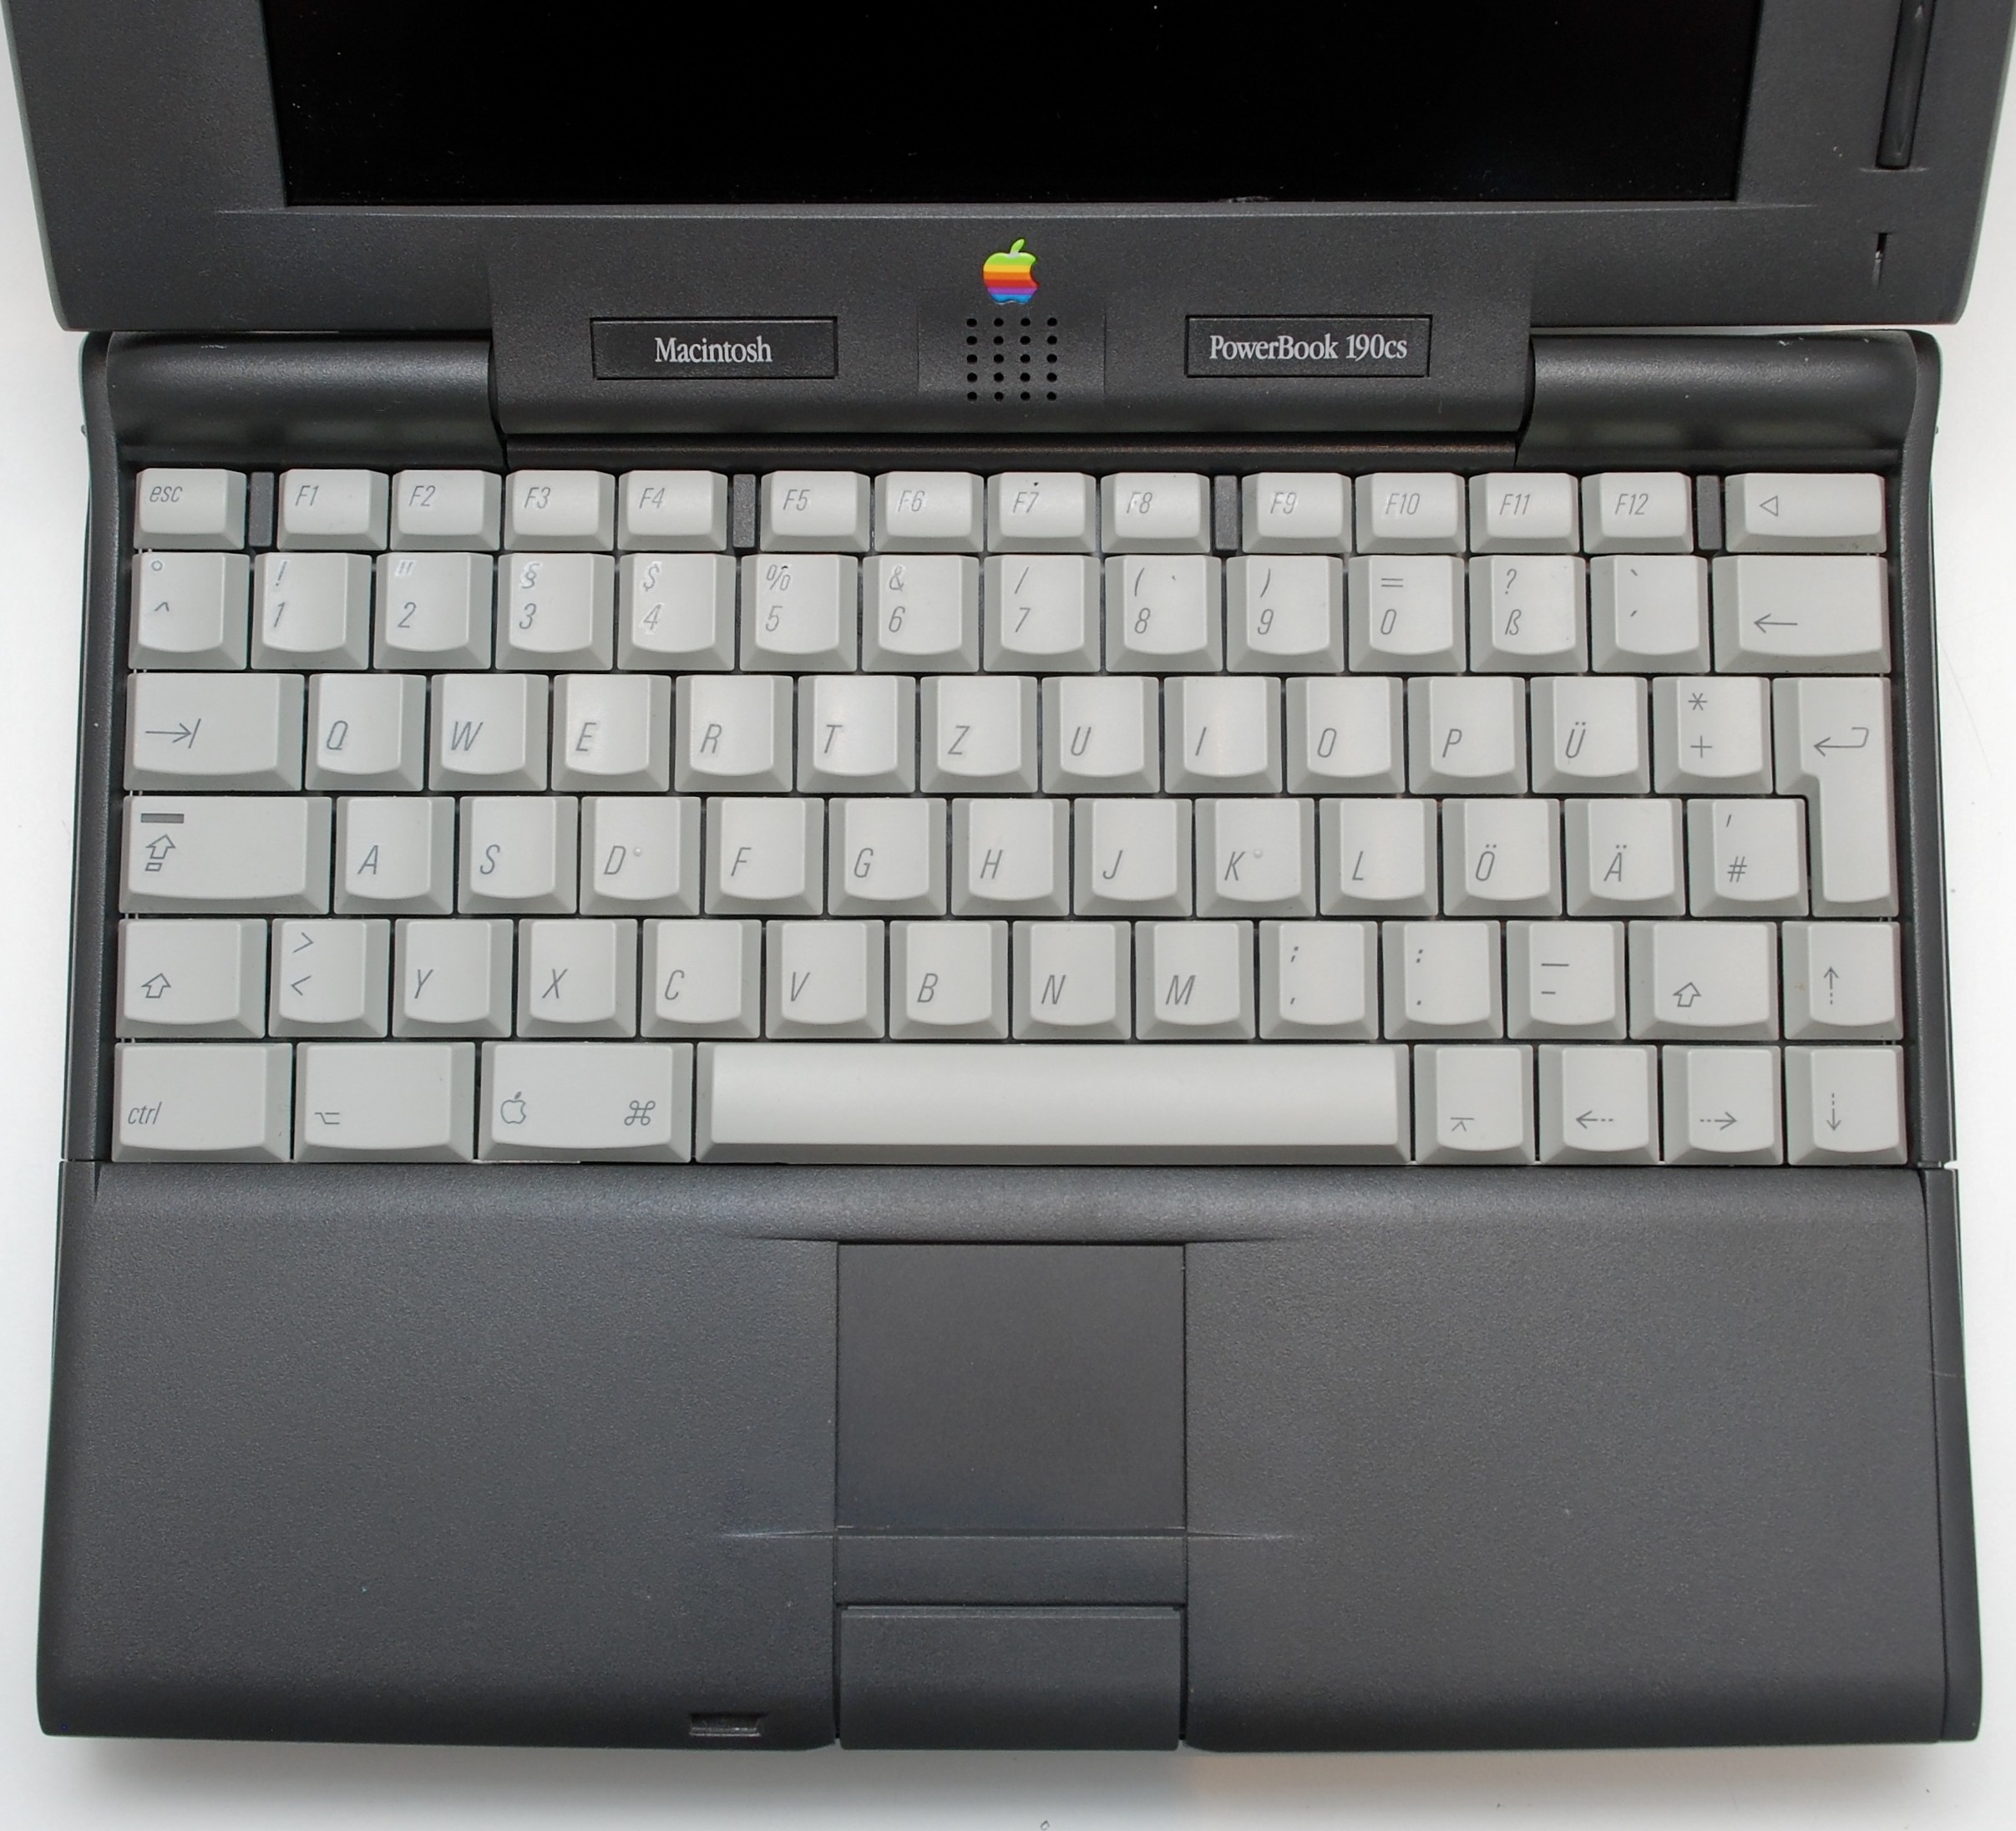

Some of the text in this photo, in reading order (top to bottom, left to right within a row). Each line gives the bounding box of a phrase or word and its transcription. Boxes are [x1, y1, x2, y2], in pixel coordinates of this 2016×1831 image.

[654, 335, 773, 363] Macintosh
[1209, 332, 1408, 362] PowerBook 190cs
[149, 485, 183, 503] esc
[295, 484, 320, 506] F1
[408, 484, 436, 507] F2
[524, 486, 551, 509] F3
[639, 487, 666, 510] F4
[783, 489, 811, 511] F5
[897, 489, 925, 513] F6
[1012, 491, 1040, 514] F7
[1126, 491, 1153, 515] F8
[1269, 491, 1297, 515] F9
[1385, 492, 1421, 515] F10
[1499, 493, 1531, 515] F11
[1614, 493, 1649, 515] F12
[275, 560, 287, 587] !
[521, 563, 539, 590] §
[643, 563, 660, 592] $
[766, 564, 791, 590] %
[889, 568, 904, 592] &
[1014, 566, 1030, 595] /
[1134, 567, 1145, 597] (
[1259, 569, 1271, 598] )
[1380, 577, 1404, 588] =
[1504, 568, 1517, 595] ?
[273, 601, 286, 628] 1
[397, 601, 417, 629] 2
[519, 602, 537, 630] 3
[643, 604, 661, 631] 4
[765, 605, 783, 632] 5
[888, 606, 906, 633] 6
[1015, 606, 1031, 633] 7
[1134, 607, 1151, 635] 8
[1257, 608, 1274, 636] 9
[326, 720, 349, 751] Q
[450, 721, 484, 752] W
[575, 722, 597, 753] E
[699, 723, 722, 754] R
[823, 723, 843, 754] T
[947, 725, 970, 756] Z
[1070, 726, 1092, 757] U
[1194, 726, 1208, 757] I
[1317, 728, 1337, 758] O
[1441, 728, 1462, 758] P
[1565, 721, 1587, 759] Ü
[1689, 735, 1713, 758] +
[357, 844, 379, 875] A
[479, 844, 501, 875] S
[603, 845, 626, 875] D
[730, 846, 752, 877] F
[854, 847, 874, 879] G
[980, 849, 1003, 880] H
[1102, 850, 1123, 880] J
[1223, 851, 1246, 881] K
[1351, 850, 1364, 881] L
[1475, 844, 1497, 882] Ö
[1603, 844, 1628, 882] Ä
[1727, 856, 1748, 883] #
[292, 931, 314, 954] >
[291, 975, 312, 997] <
[413, 969, 434, 999] Y
[541, 968, 568, 999] X
[664, 969, 685, 1001] C
[790, 971, 811, 1002] V
[916, 972, 939, 1003] B
[1041, 974, 1066, 1005] N
[1165, 974, 1196, 1006] M
[127, 1101, 163, 1125] ctrl
